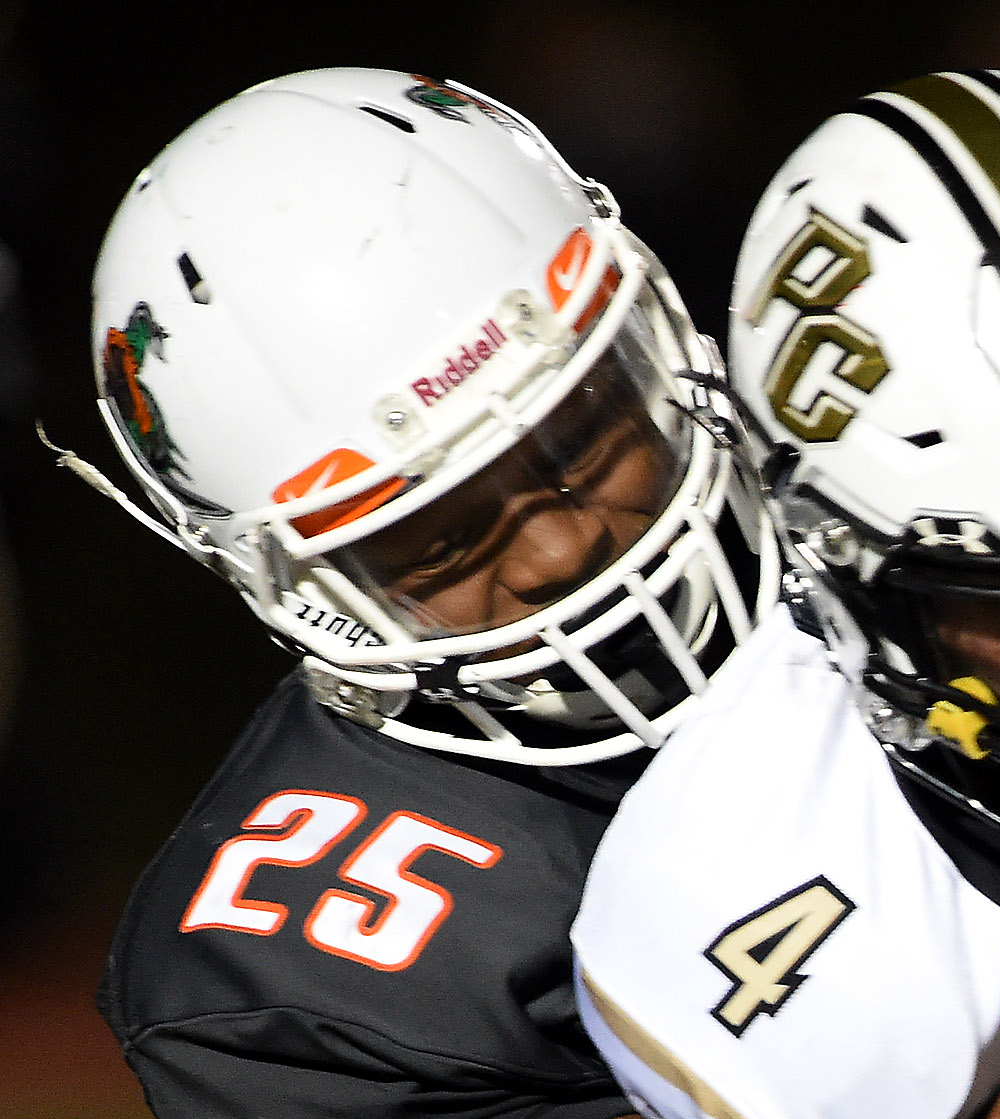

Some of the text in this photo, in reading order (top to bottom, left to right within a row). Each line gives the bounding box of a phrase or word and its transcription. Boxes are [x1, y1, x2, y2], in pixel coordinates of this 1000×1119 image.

[411, 319, 506, 406] Riddell
[180, 788, 503, 972] 25
[703, 875, 856, 1038] 4
